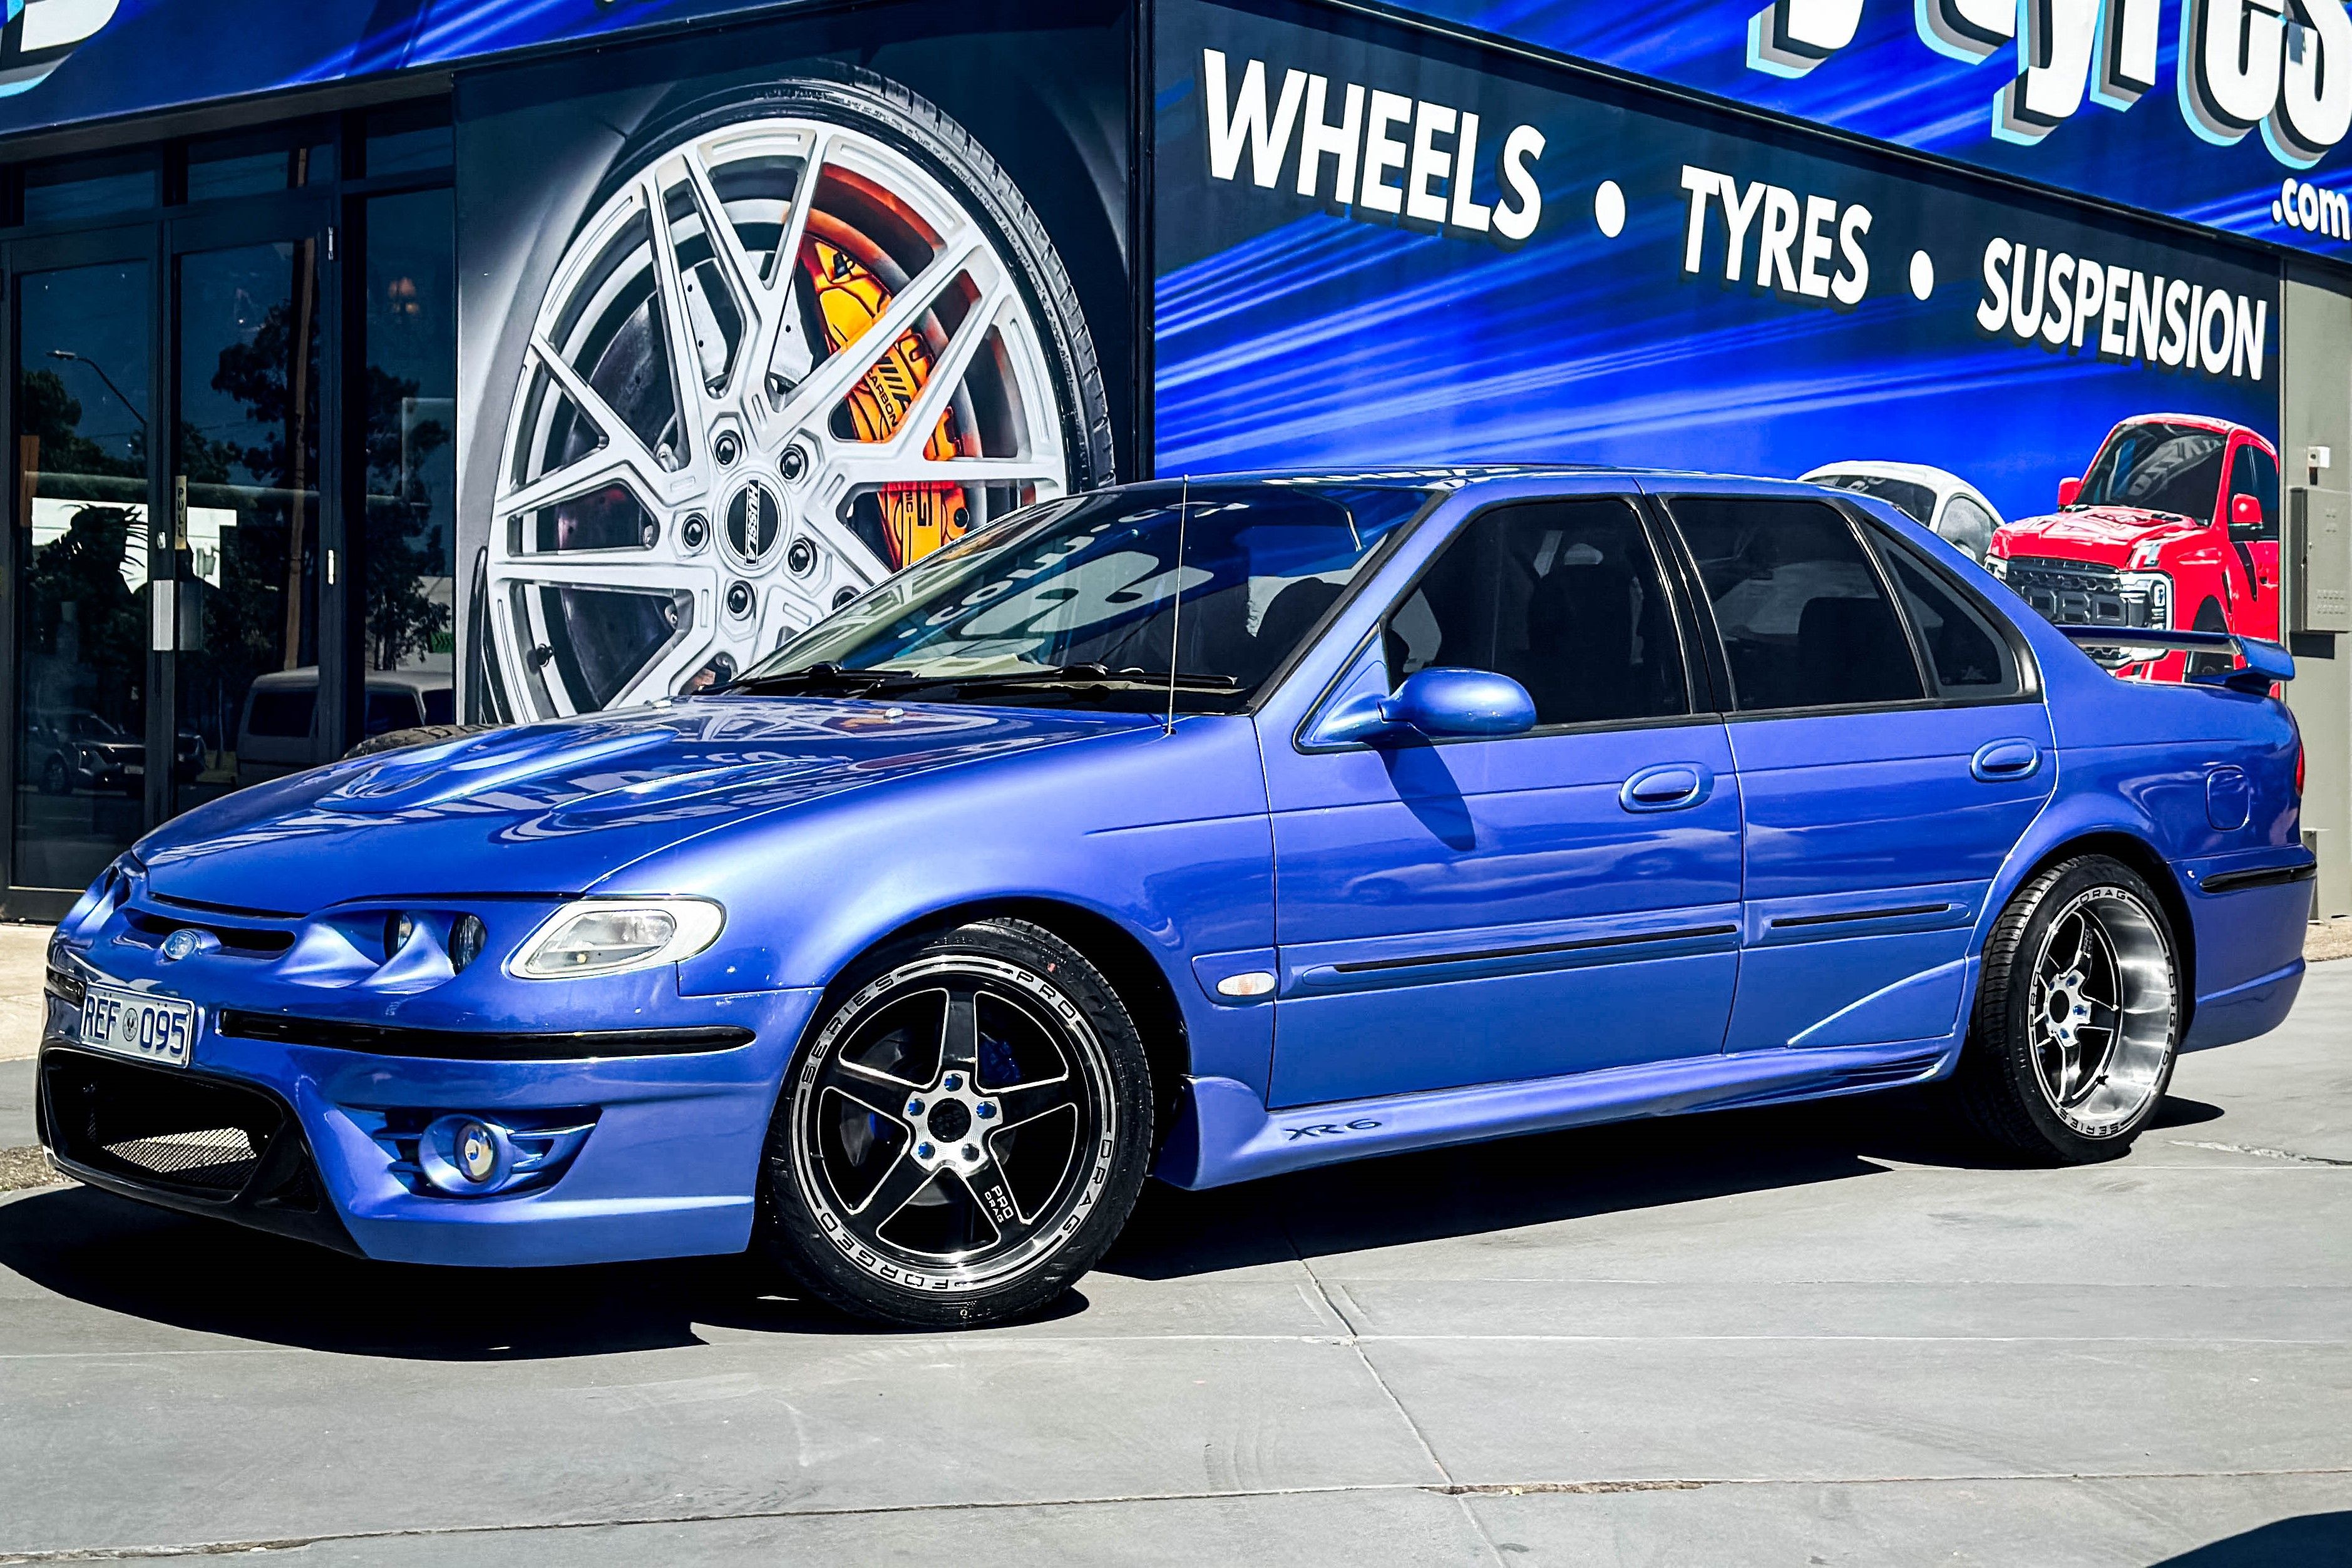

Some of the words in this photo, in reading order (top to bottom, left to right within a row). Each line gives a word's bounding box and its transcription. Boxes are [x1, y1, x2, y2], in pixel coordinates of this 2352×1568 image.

[1204, 48, 1546, 240] WHEELS
[1681, 165, 1872, 305] TYRES
[1976, 237, 2266, 381] SUSPENSION
[2272, 178, 2351, 241] .com
[2022, 585, 2127, 625] ORD
[2080, 889, 2126, 904] DRAG
[1016, 971, 1076, 1019] PRO
[84, 993, 121, 1040] REF
[140, 1007, 188, 1055] 095
[801, 974, 894, 1084] SERIES
[1285, 1118, 1382, 1140] XR6
[2059, 1107, 2119, 1135] SERIES
[984, 1191, 1004, 1223] DRAG
[991, 1185, 1014, 1219] PRO
[1062, 1139, 1113, 1235] DRAG
[821, 1212, 949, 1289] FORGED
